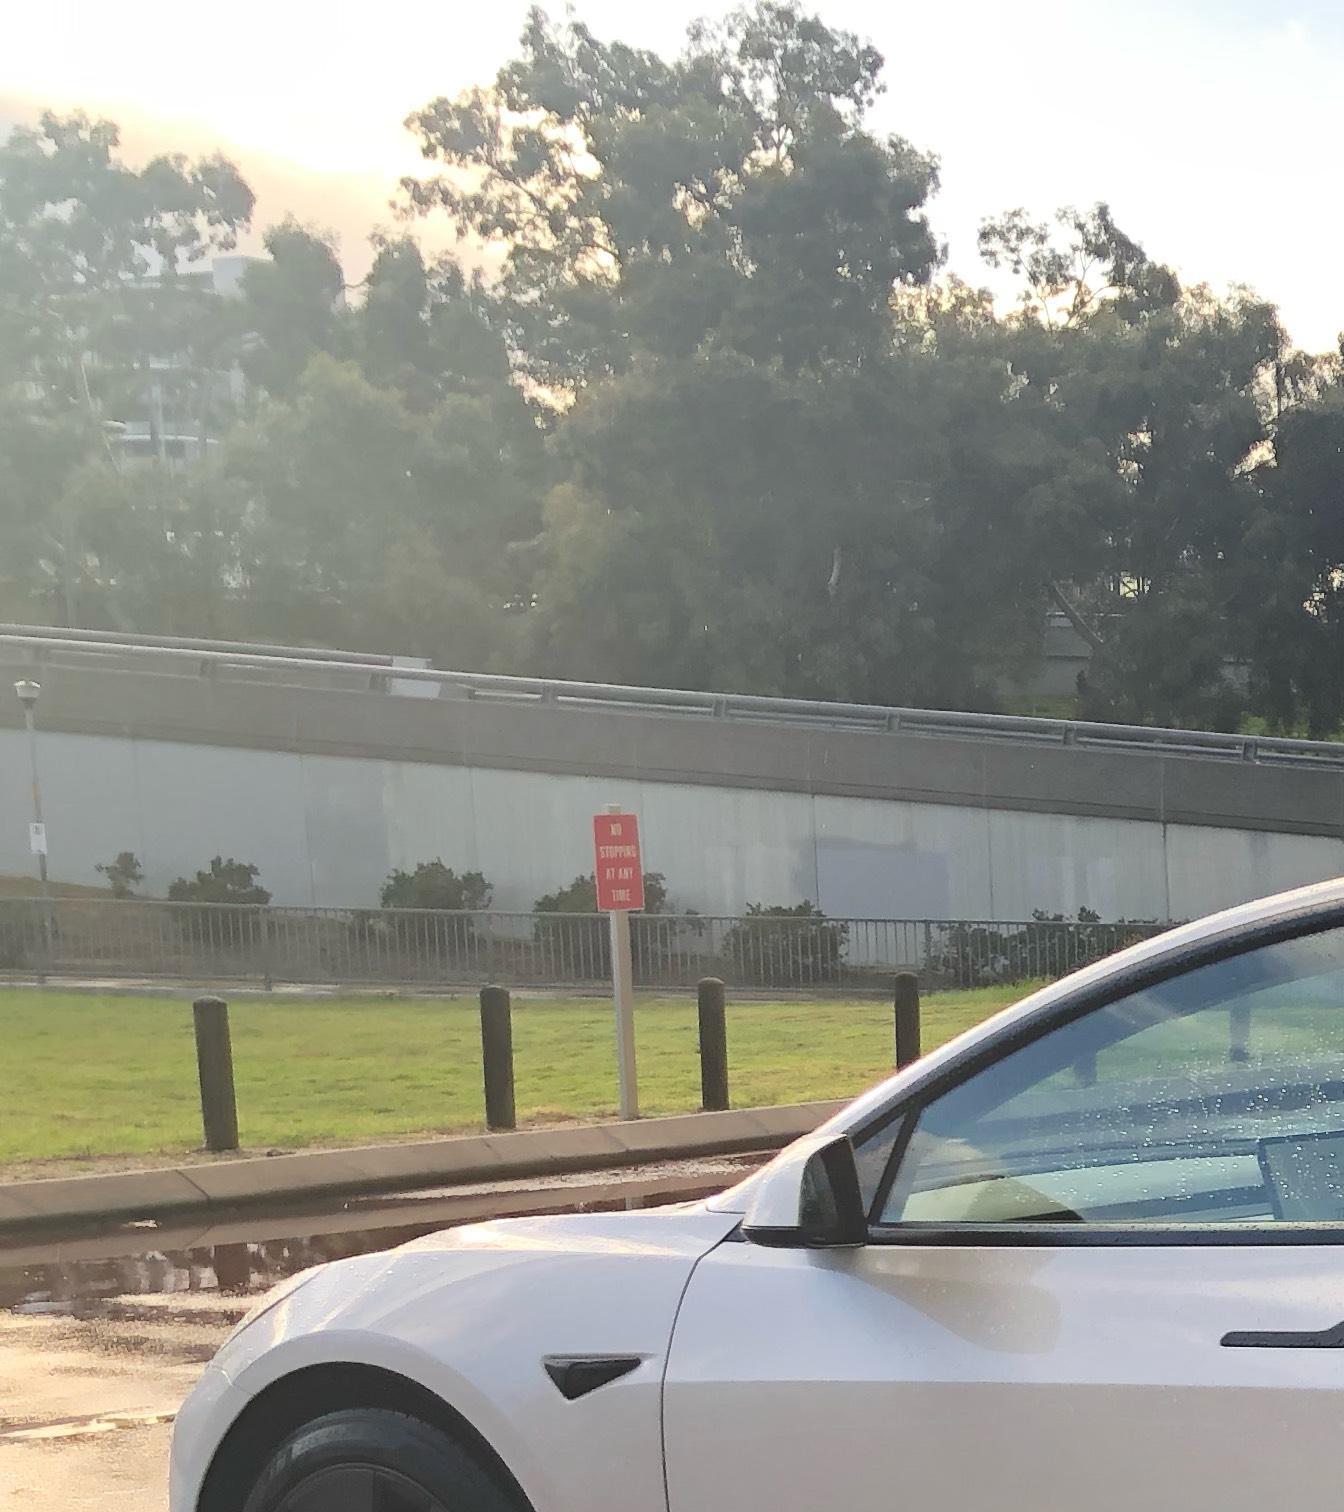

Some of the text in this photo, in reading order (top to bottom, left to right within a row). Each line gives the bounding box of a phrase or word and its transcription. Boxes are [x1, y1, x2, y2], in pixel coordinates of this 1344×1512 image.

[610, 823, 623, 837] NO
[600, 845, 637, 858] STOPPING
[606, 867, 633, 881] AT ANY
[612, 888, 631, 902] TIME
